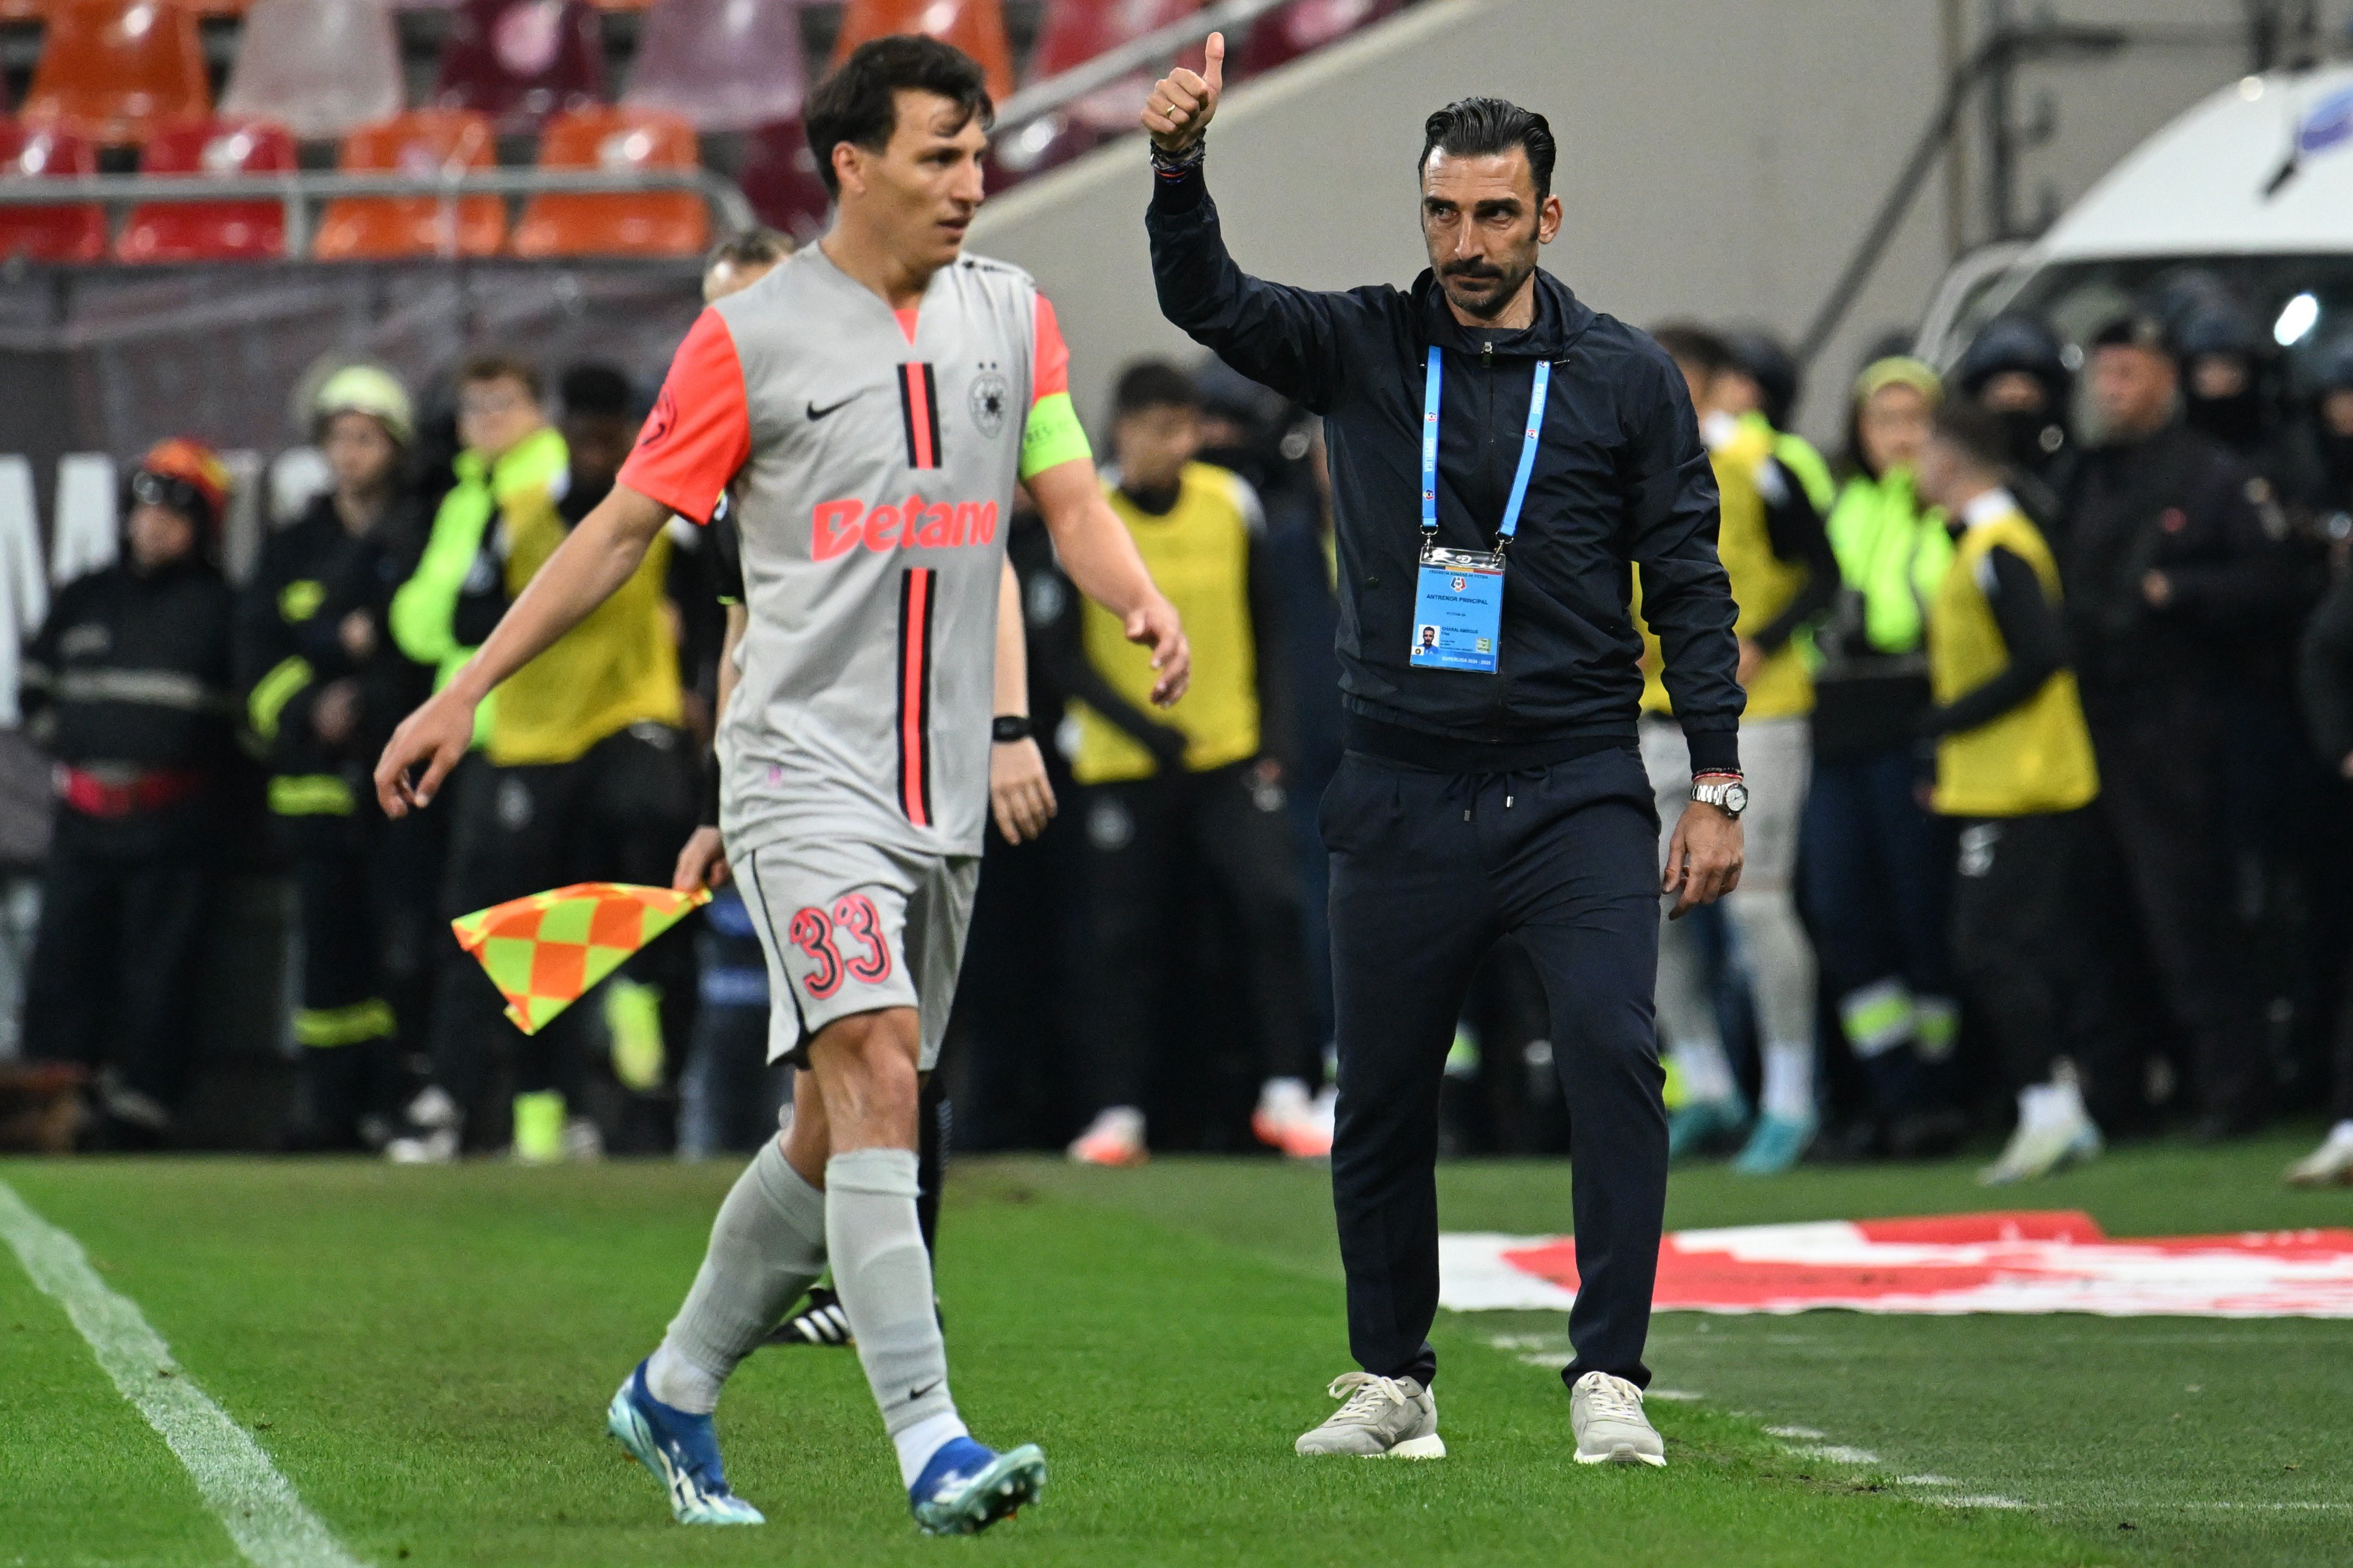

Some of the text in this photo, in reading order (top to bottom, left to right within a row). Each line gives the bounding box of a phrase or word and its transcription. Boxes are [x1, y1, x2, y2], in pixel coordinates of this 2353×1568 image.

[1531, 383, 1545, 415] SUPERLIGA
[1424, 437, 1434, 473] SUPERLIGA
[811, 494, 998, 562] Betano
[789, 893, 891, 1000] 33
